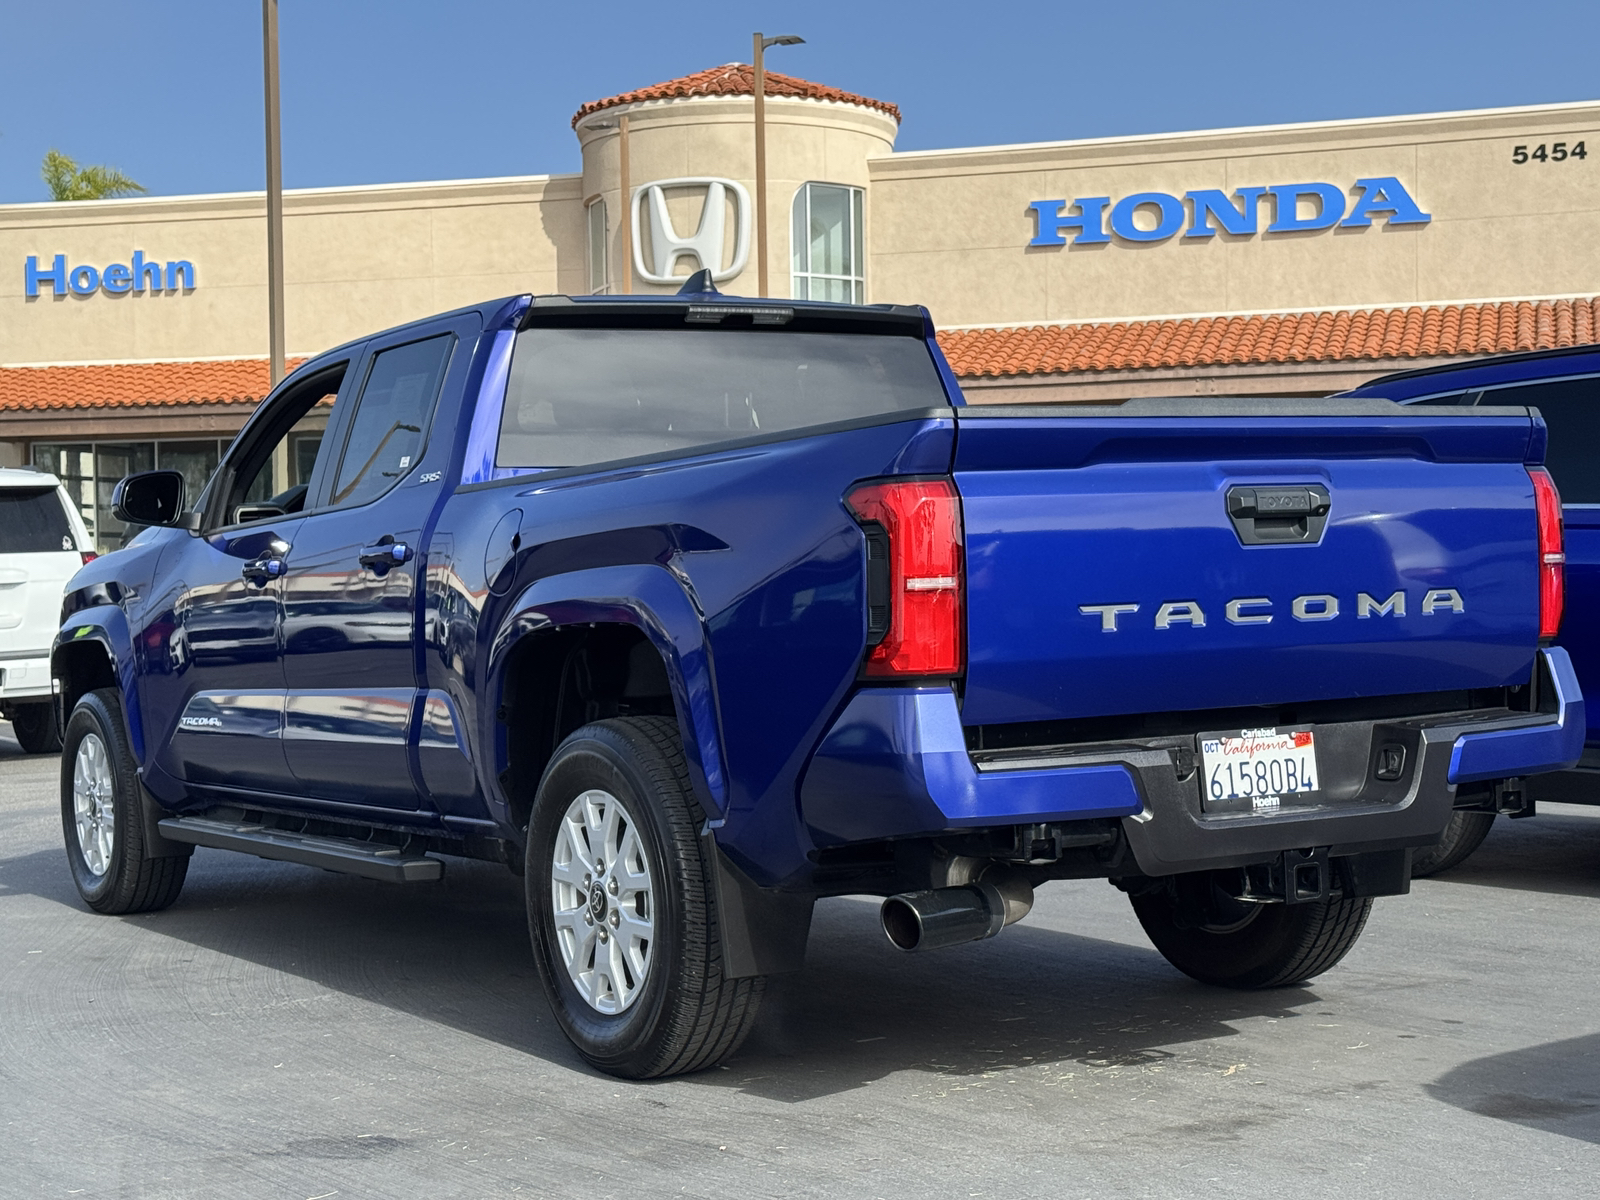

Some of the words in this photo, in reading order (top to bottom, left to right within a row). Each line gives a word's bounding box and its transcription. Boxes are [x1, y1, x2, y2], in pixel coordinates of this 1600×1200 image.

[1513, 141, 1589, 164] 5454
[1030, 176, 1431, 247] HONDA
[25, 250, 195, 297] Hoehn
[1259, 495, 1308, 508] TOYOTA
[1078, 588, 1465, 633] TACOMA
[180, 717, 219, 726] TACOMA
[1241, 727, 1276, 739] Carlsbad
[1204, 742, 1219, 753] OCT
[1222, 737, 1295, 759] California
[1210, 757, 1313, 800] 61580B4
[1252, 796, 1280, 808] Hoehn
